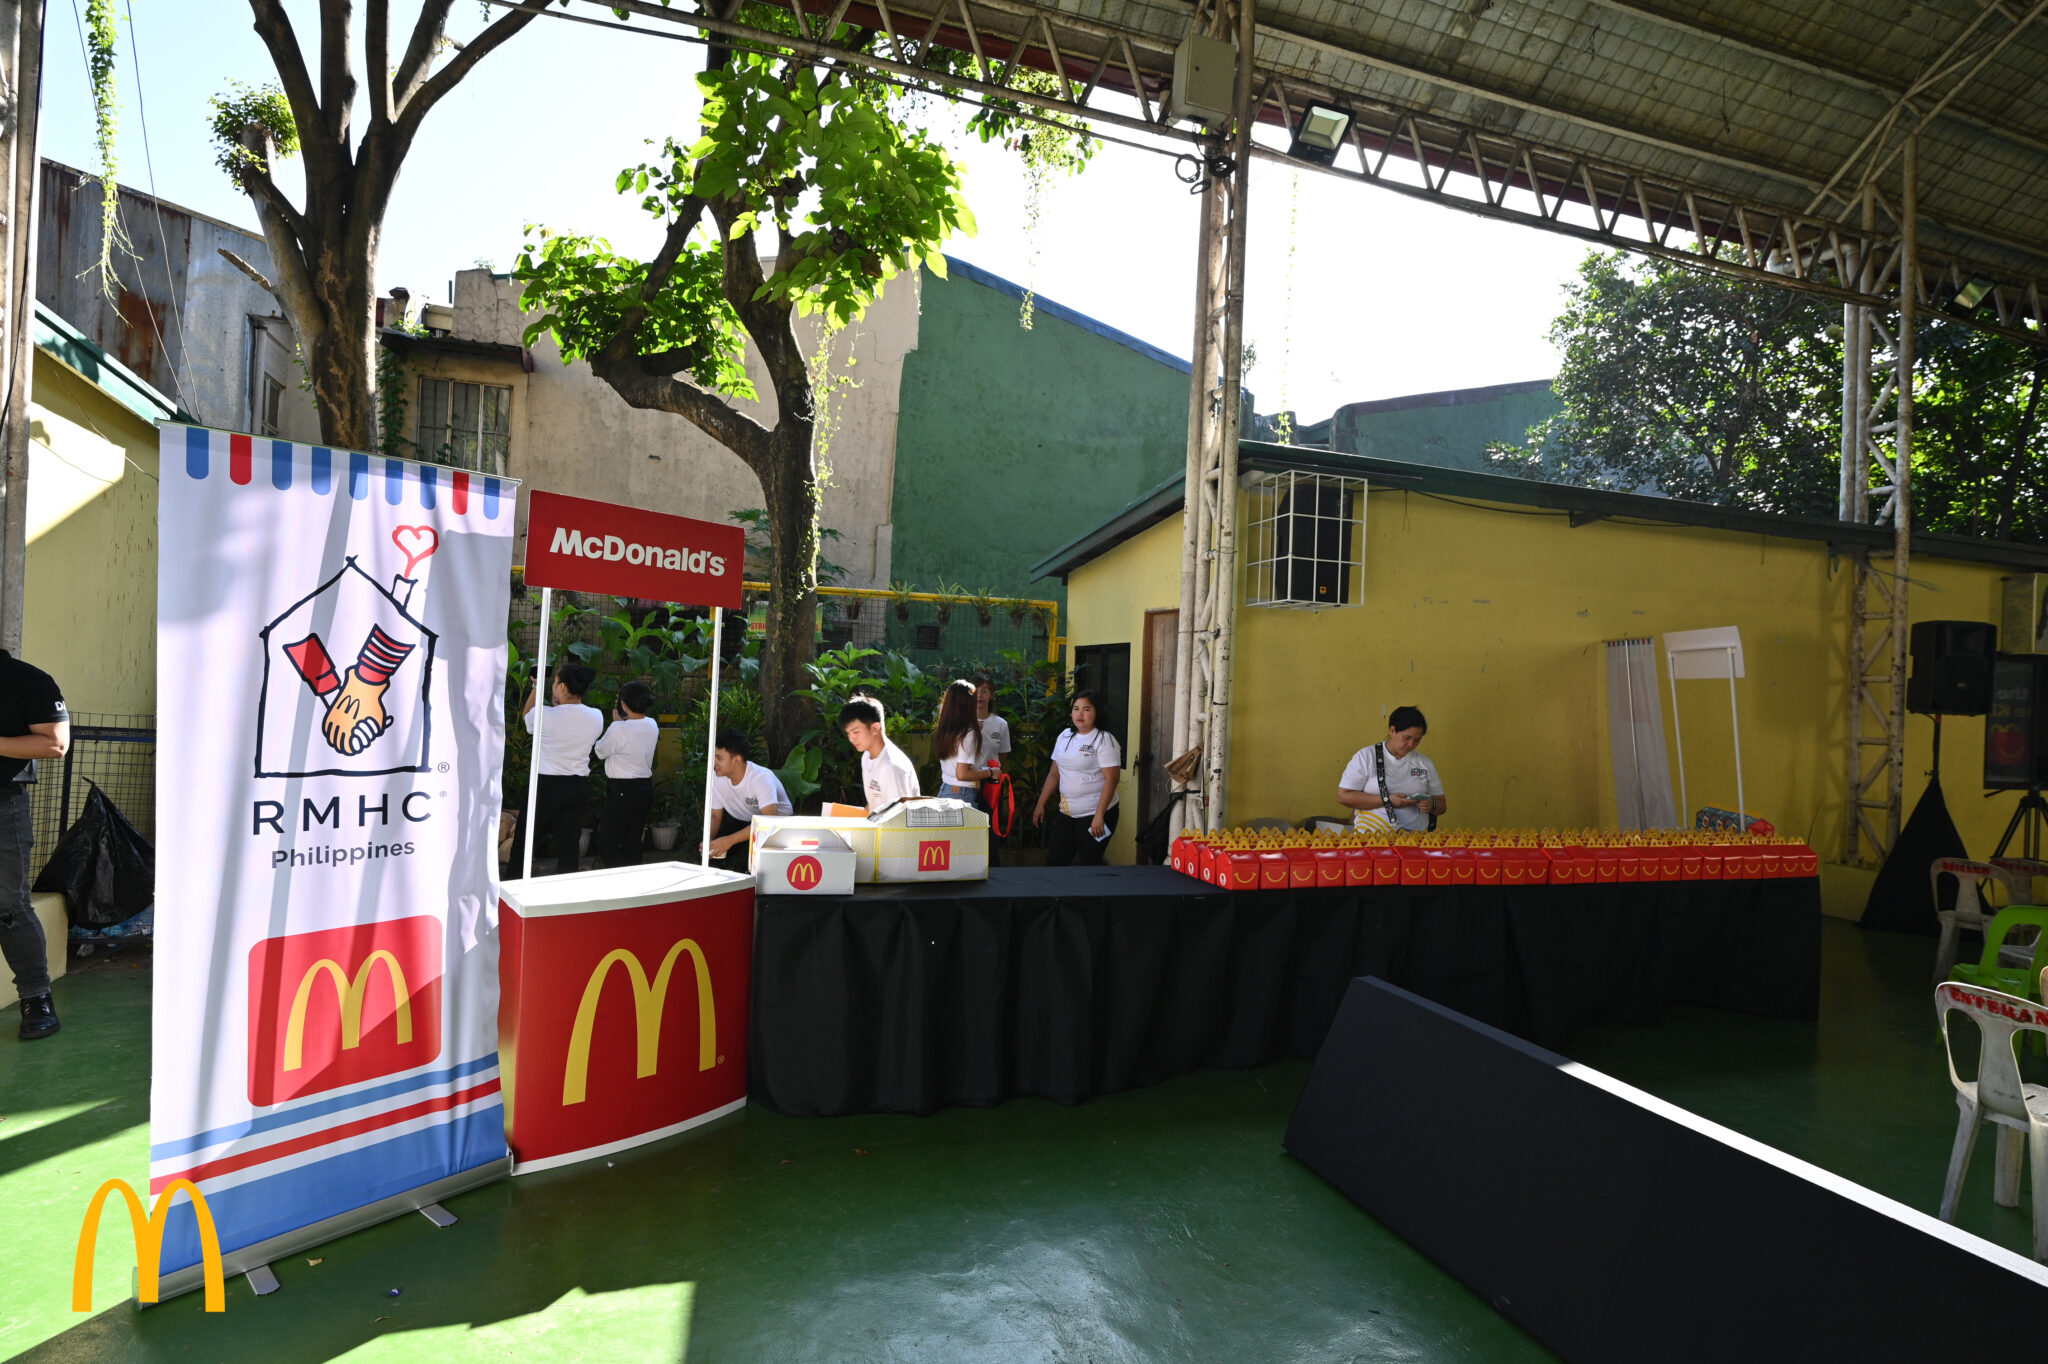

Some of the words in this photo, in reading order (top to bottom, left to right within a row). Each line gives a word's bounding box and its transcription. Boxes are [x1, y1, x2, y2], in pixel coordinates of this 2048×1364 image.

[550, 527, 726, 577] McDonald's
[253, 791, 431, 835] RMHC
[271, 842, 415, 868] Philippines
